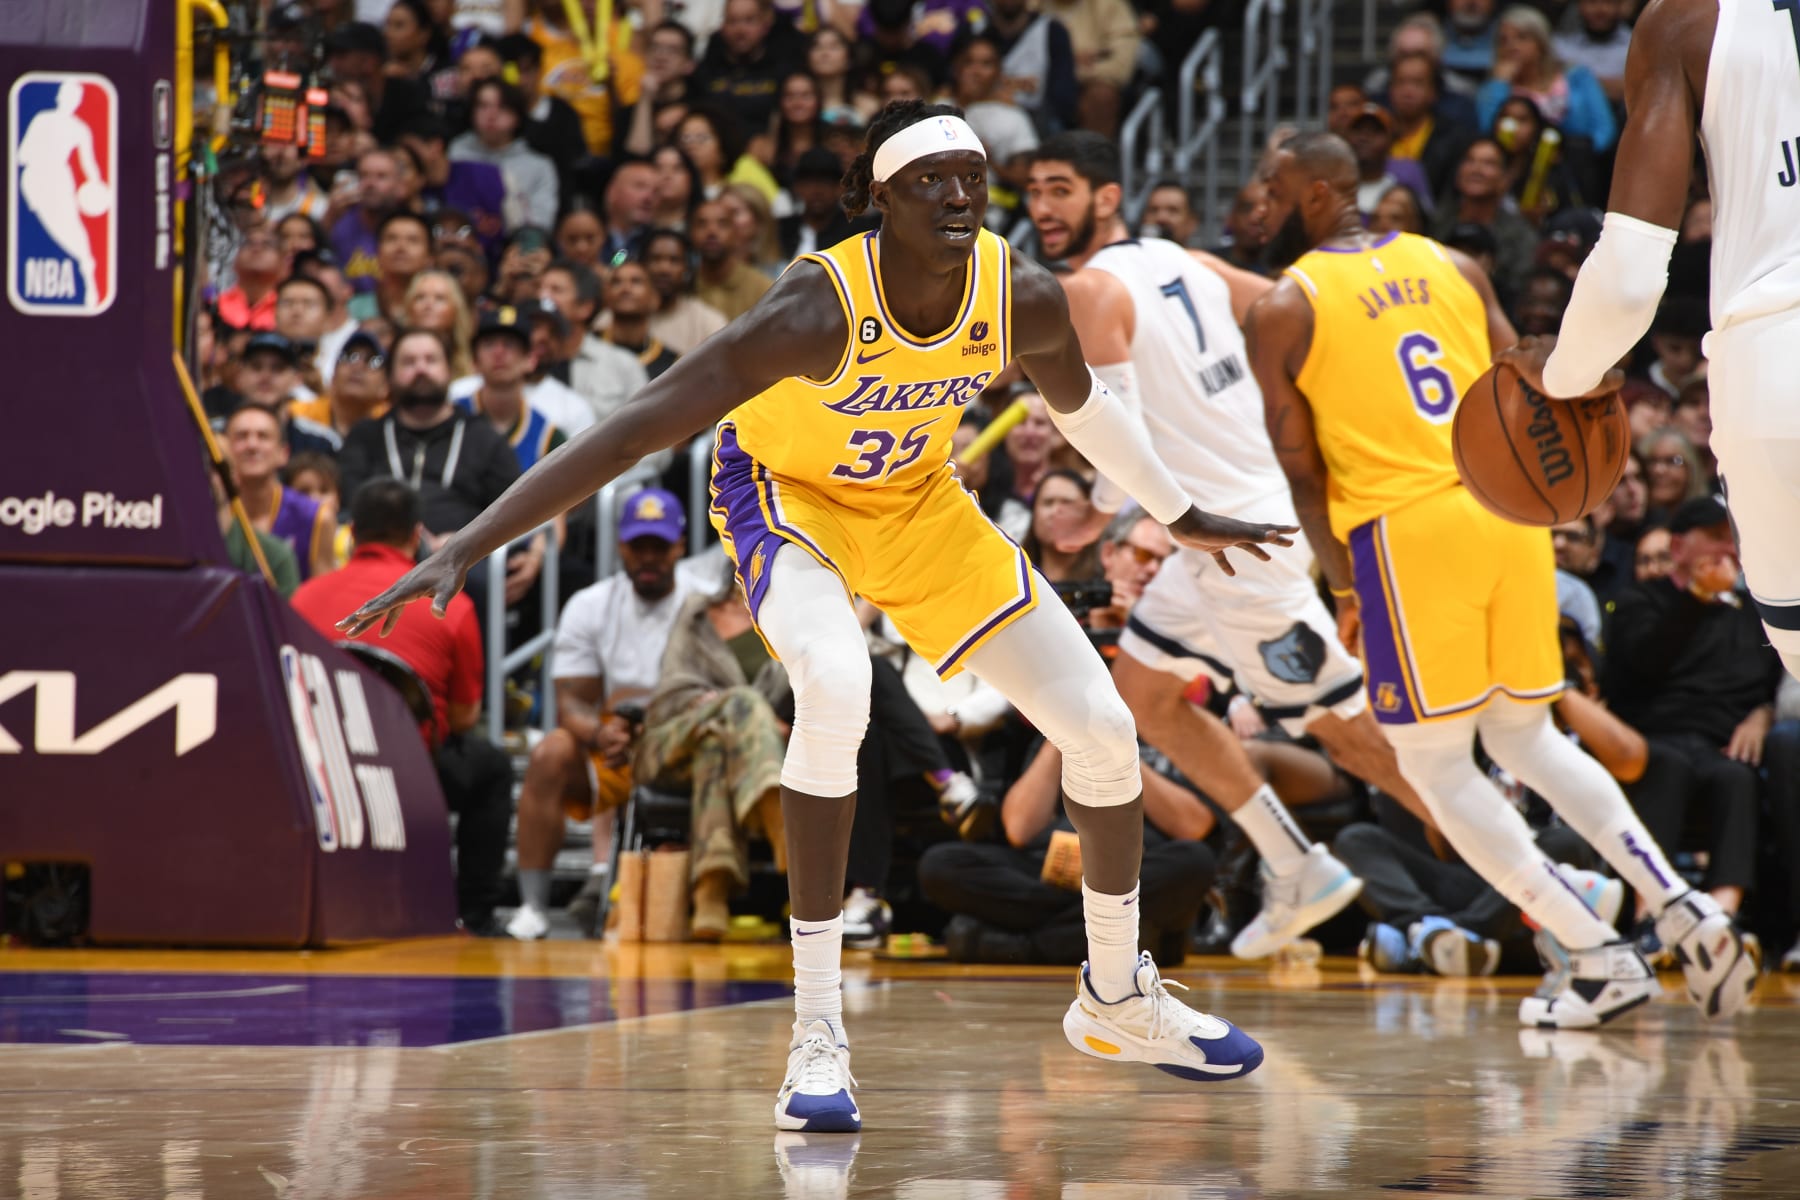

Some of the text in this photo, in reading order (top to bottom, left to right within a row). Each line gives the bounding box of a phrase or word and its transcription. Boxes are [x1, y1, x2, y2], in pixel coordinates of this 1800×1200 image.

[1778, 136, 1800, 187] J
[25, 257, 76, 299] NBA
[1357, 278, 1432, 320] JAMES
[861, 319, 877, 342] 6
[961, 342, 996, 357] bibigo
[820, 371, 993, 417] LAKERS
[1395, 330, 1458, 425] 6
[829, 416, 943, 484] 35
[82, 491, 163, 529] Pixel
